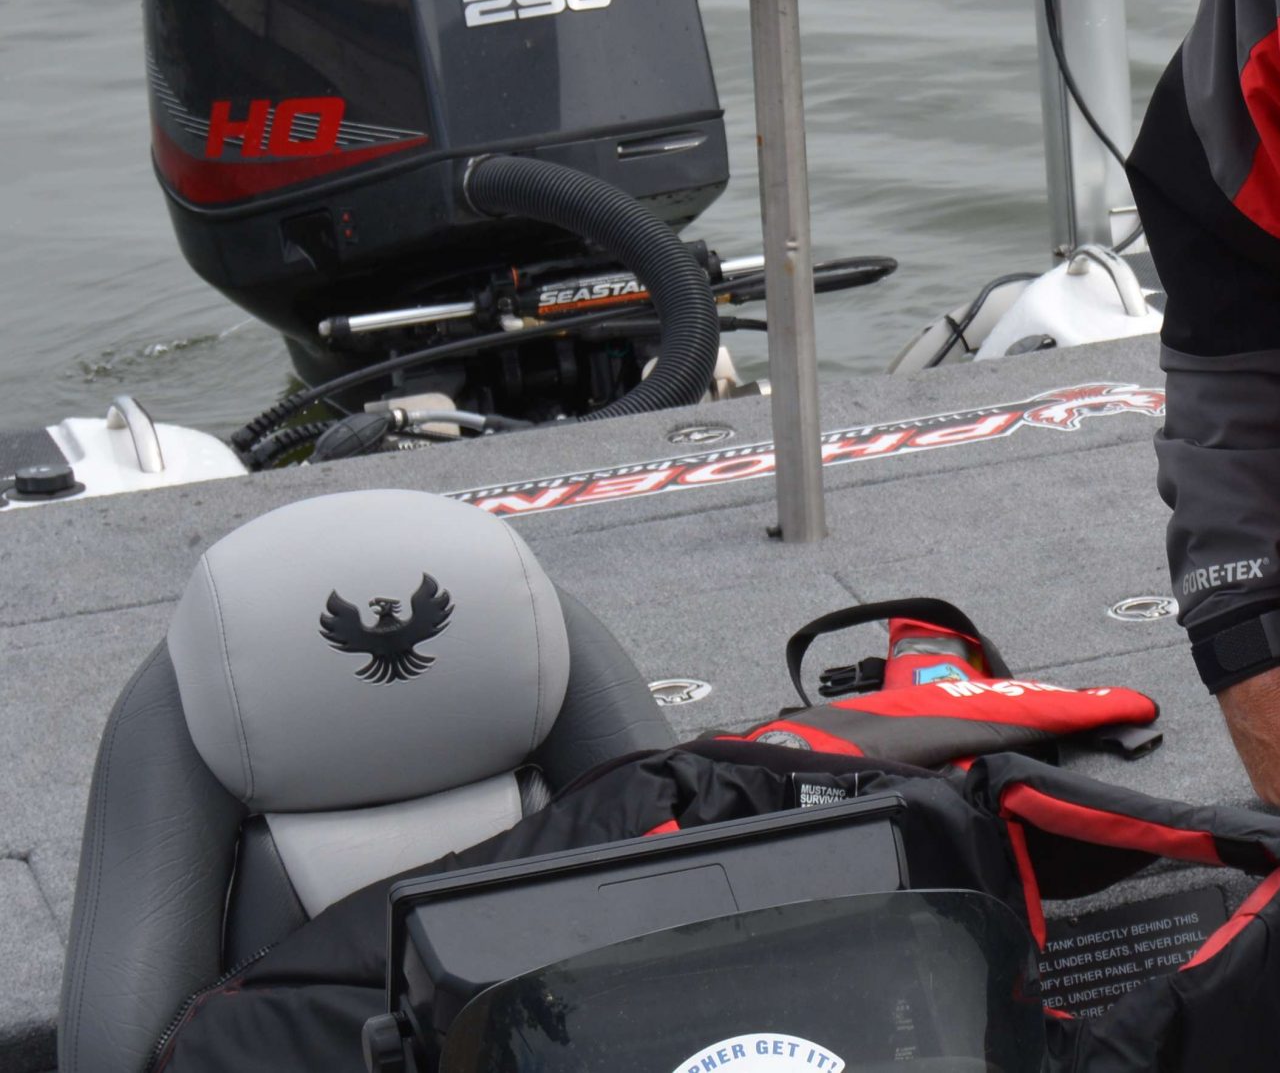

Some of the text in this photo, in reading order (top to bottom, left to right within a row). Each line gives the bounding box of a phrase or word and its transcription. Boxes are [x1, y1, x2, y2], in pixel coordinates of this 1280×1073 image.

[204, 96, 346, 158] HO
[474, 411, 1023, 514] PHOEN
[1182, 558, 1264, 596] GORE-TEX
[1046, 913, 1199, 953] TANK DIRECTLY BEHIND THIS
[1038, 961, 1053, 973] EL
[1054, 953, 1094, 970] UNDER
[1134, 936, 1172, 953] NEVER
[1063, 969, 1103, 986] EITHER
[1144, 957, 1155, 969] IF
[1157, 953, 1186, 967] FUEL
[687, 1040, 838, 1073] PHER GET IT!
